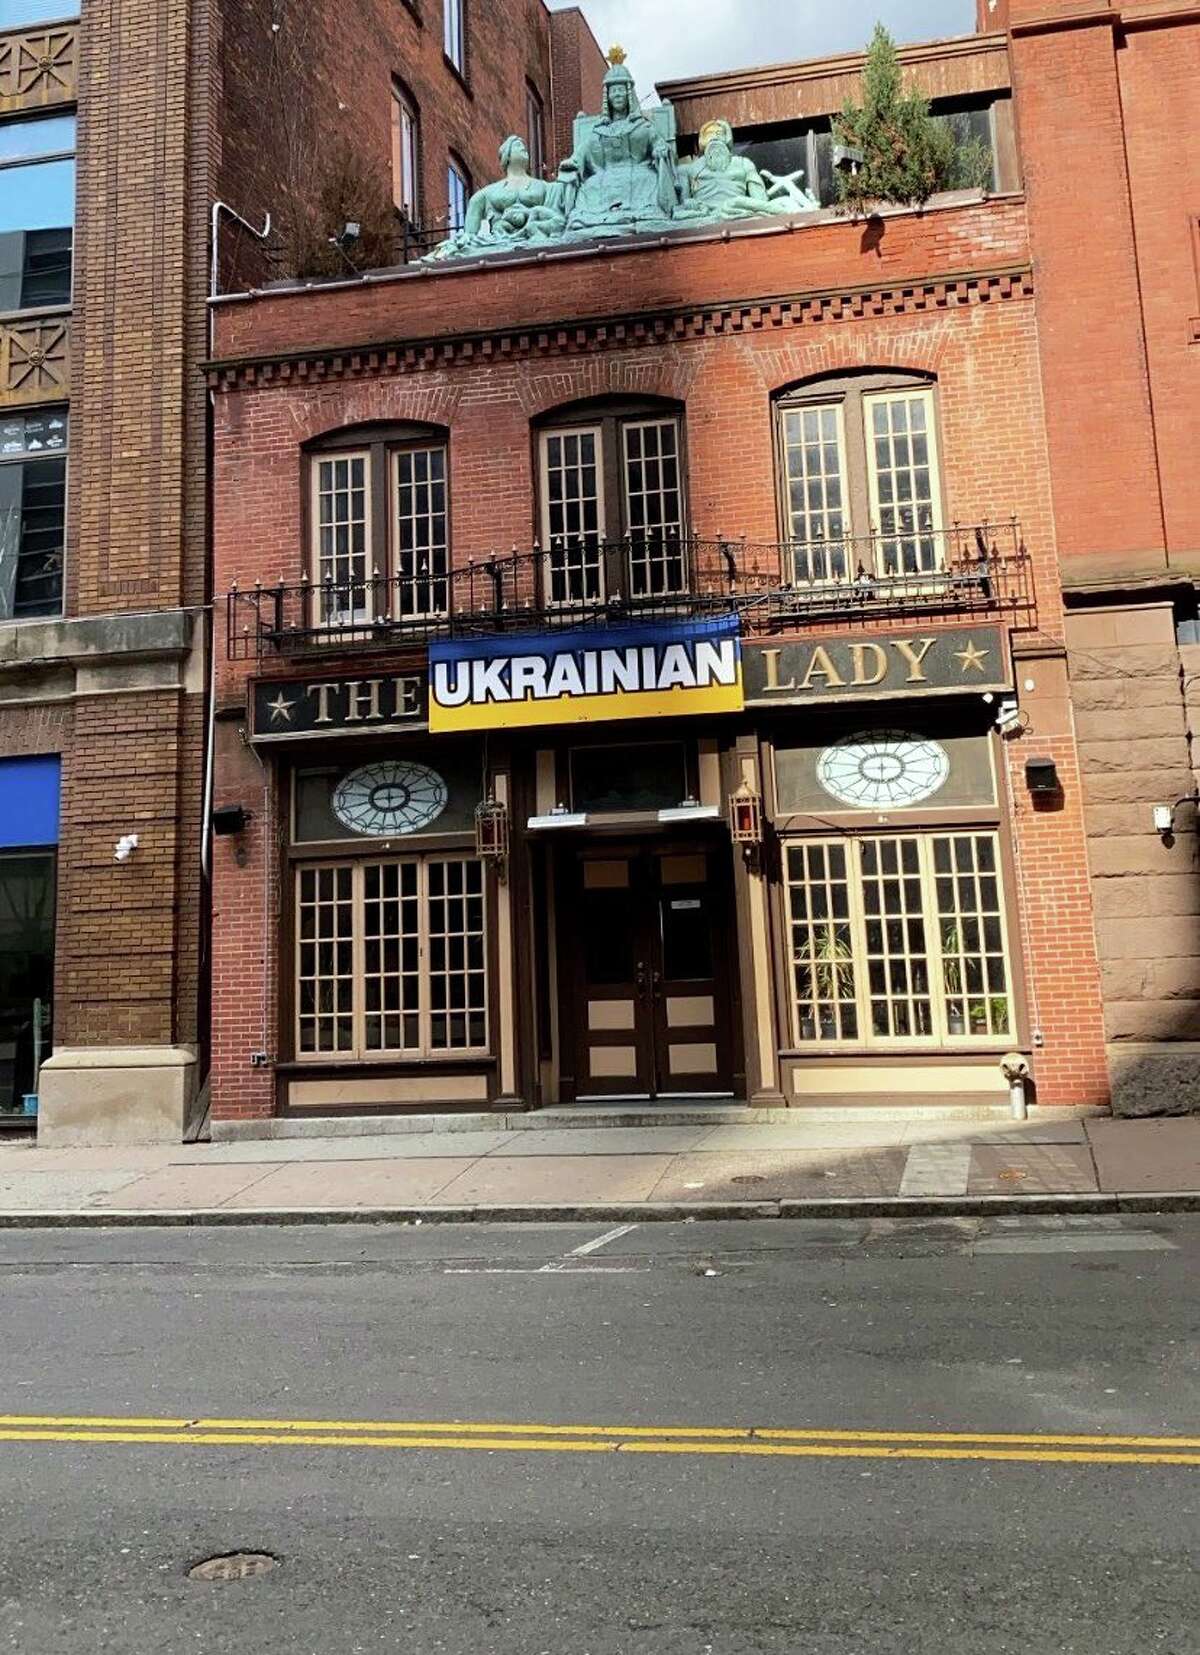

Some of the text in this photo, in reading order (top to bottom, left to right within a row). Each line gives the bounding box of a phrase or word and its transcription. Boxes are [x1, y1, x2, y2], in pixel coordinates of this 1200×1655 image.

[433, 639, 737, 706] UKRAINIAN
[761, 637, 937, 692] LADY
[306, 676, 421, 723] THE
